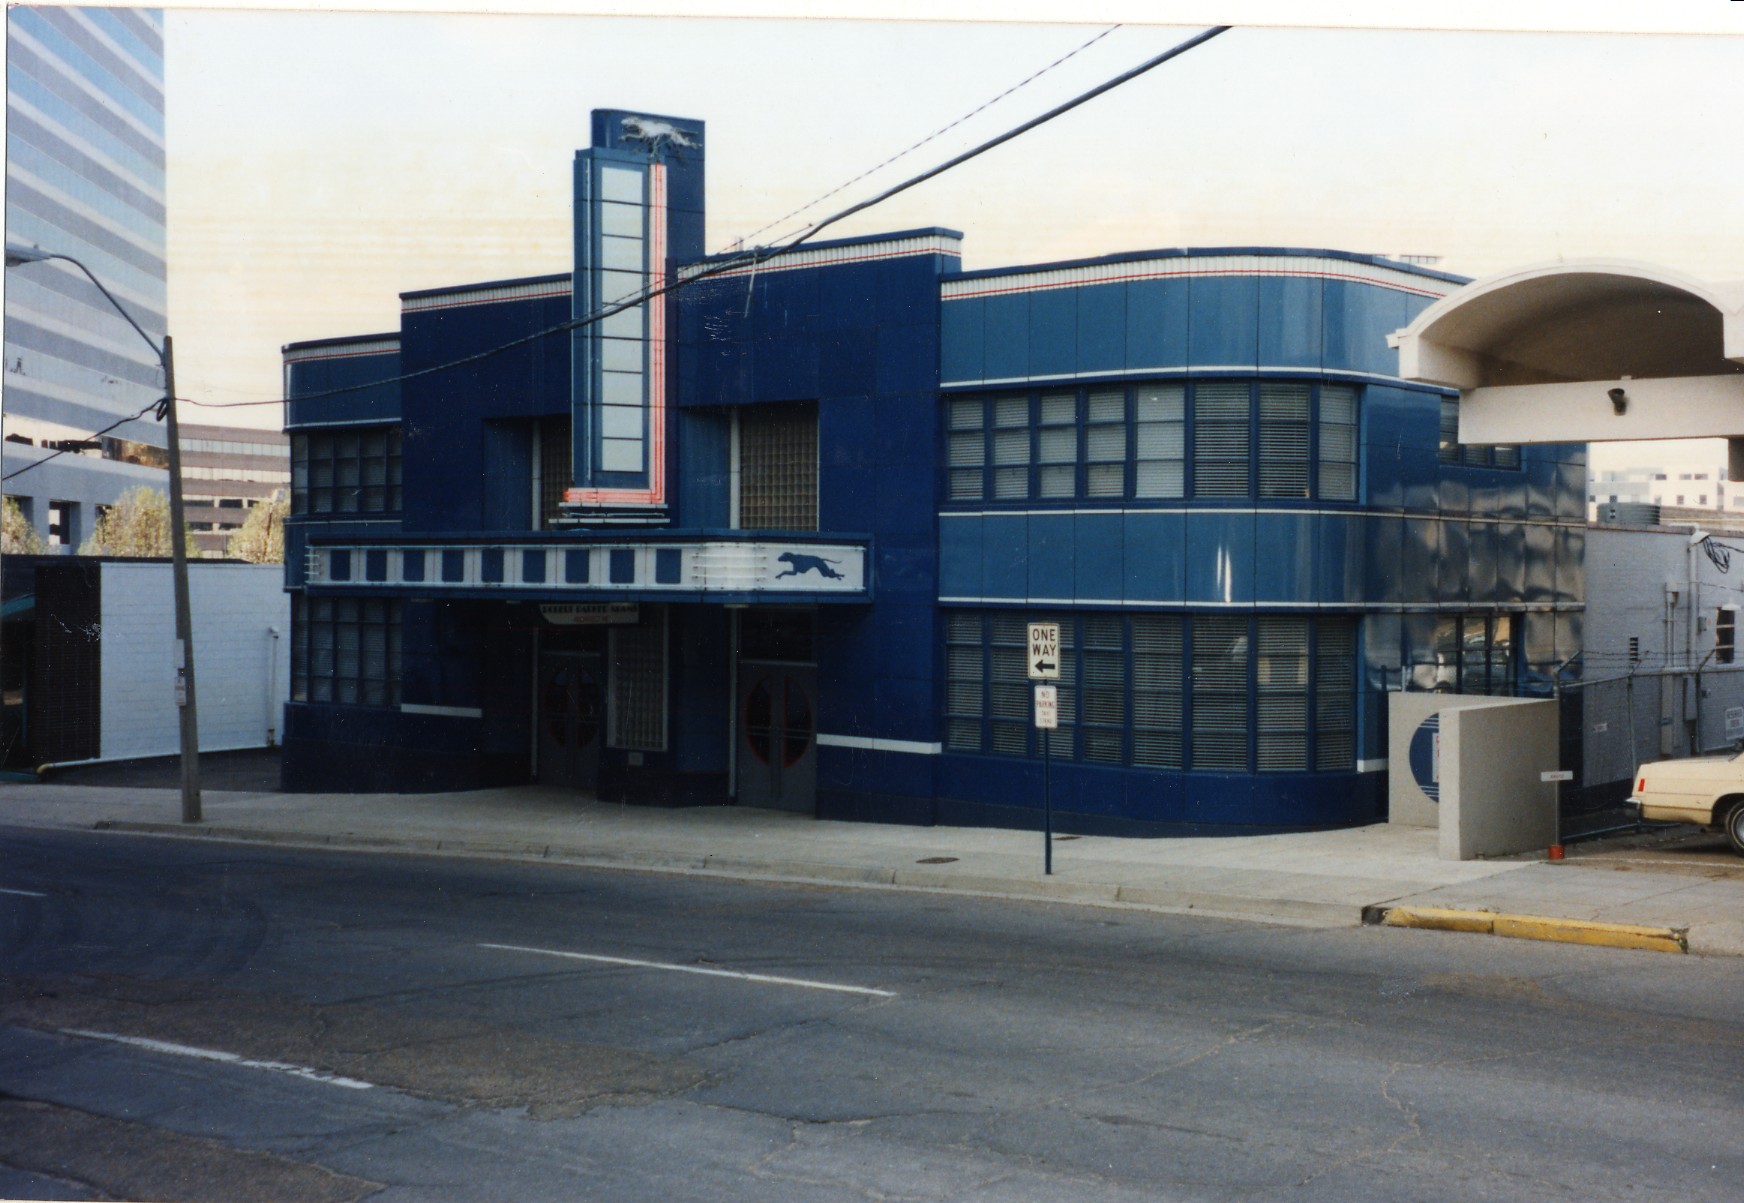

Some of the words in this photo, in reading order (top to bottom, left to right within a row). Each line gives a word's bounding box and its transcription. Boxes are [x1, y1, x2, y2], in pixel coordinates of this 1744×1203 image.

[1032, 628, 1056, 641] ONE
[1032, 643, 1056, 656] WAY
[1041, 690, 1050, 699] NO
[1036, 700, 1055, 708] PARKING
